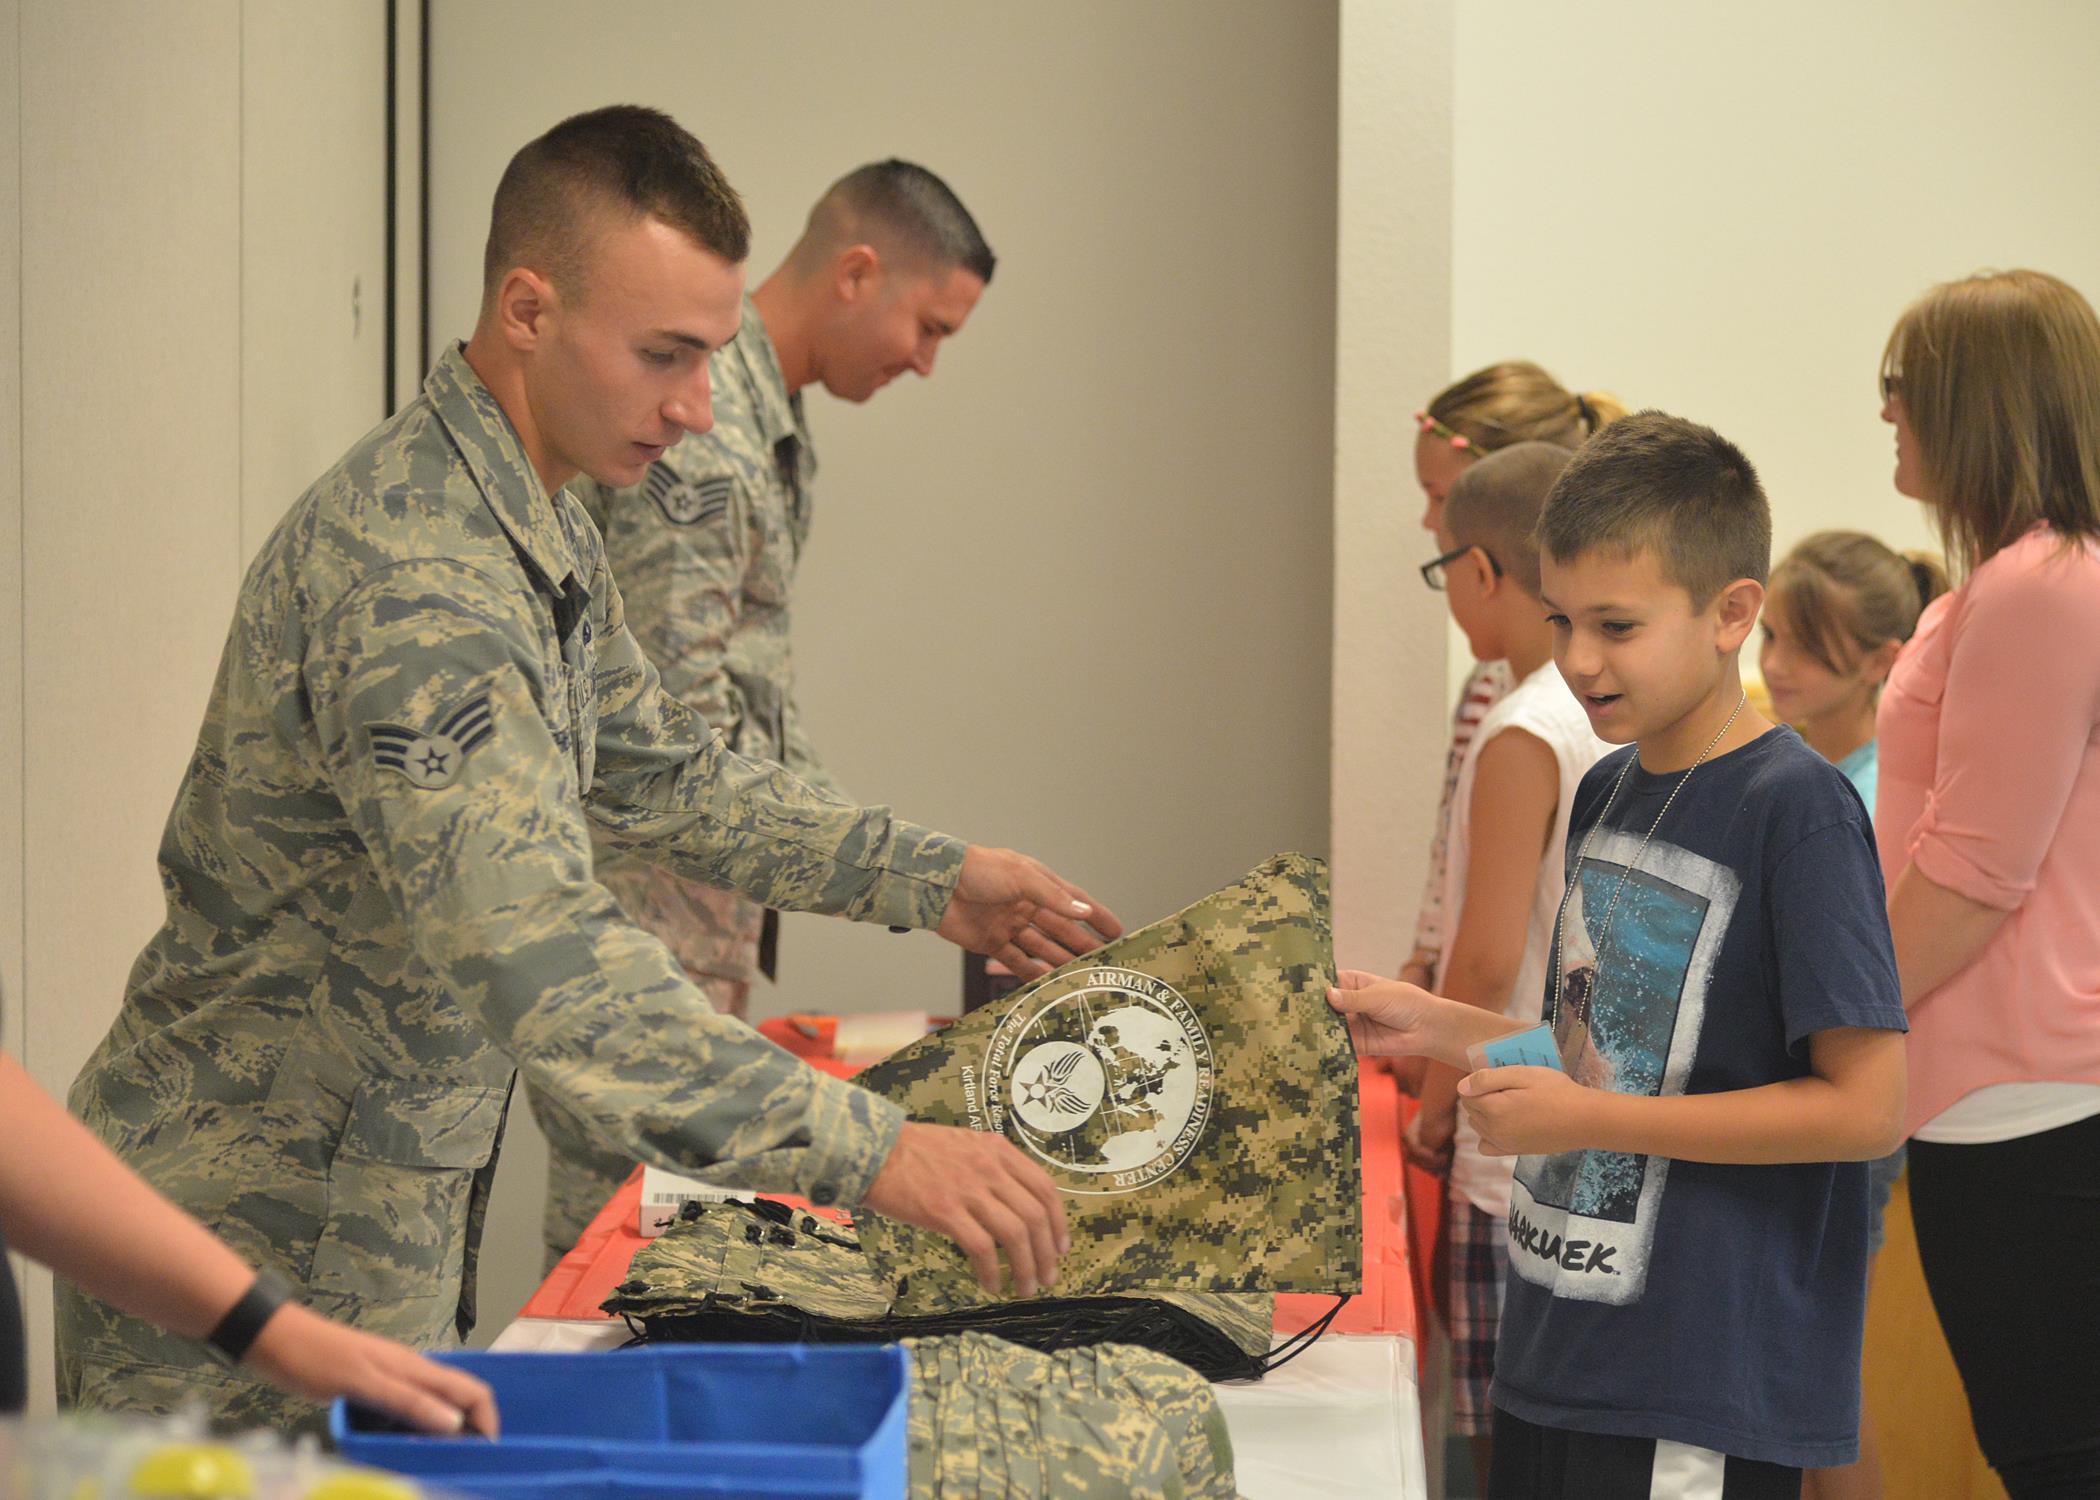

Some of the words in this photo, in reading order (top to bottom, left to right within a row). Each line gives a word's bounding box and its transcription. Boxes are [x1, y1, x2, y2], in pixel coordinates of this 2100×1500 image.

[1087, 971, 1157, 995] AIRMAN
[1156, 988, 1170, 1003] &
[1006, 1012, 1027, 1034] The
[1169, 998, 1209, 1062] FAMILY
[991, 1034, 1012, 1068] Total
[961, 1065, 980, 1113] Kirtland
[988, 1068, 1001, 1102] Force
[1172, 1066, 1210, 1156] READINESS
[1112, 1152, 1175, 1187] CENTER
